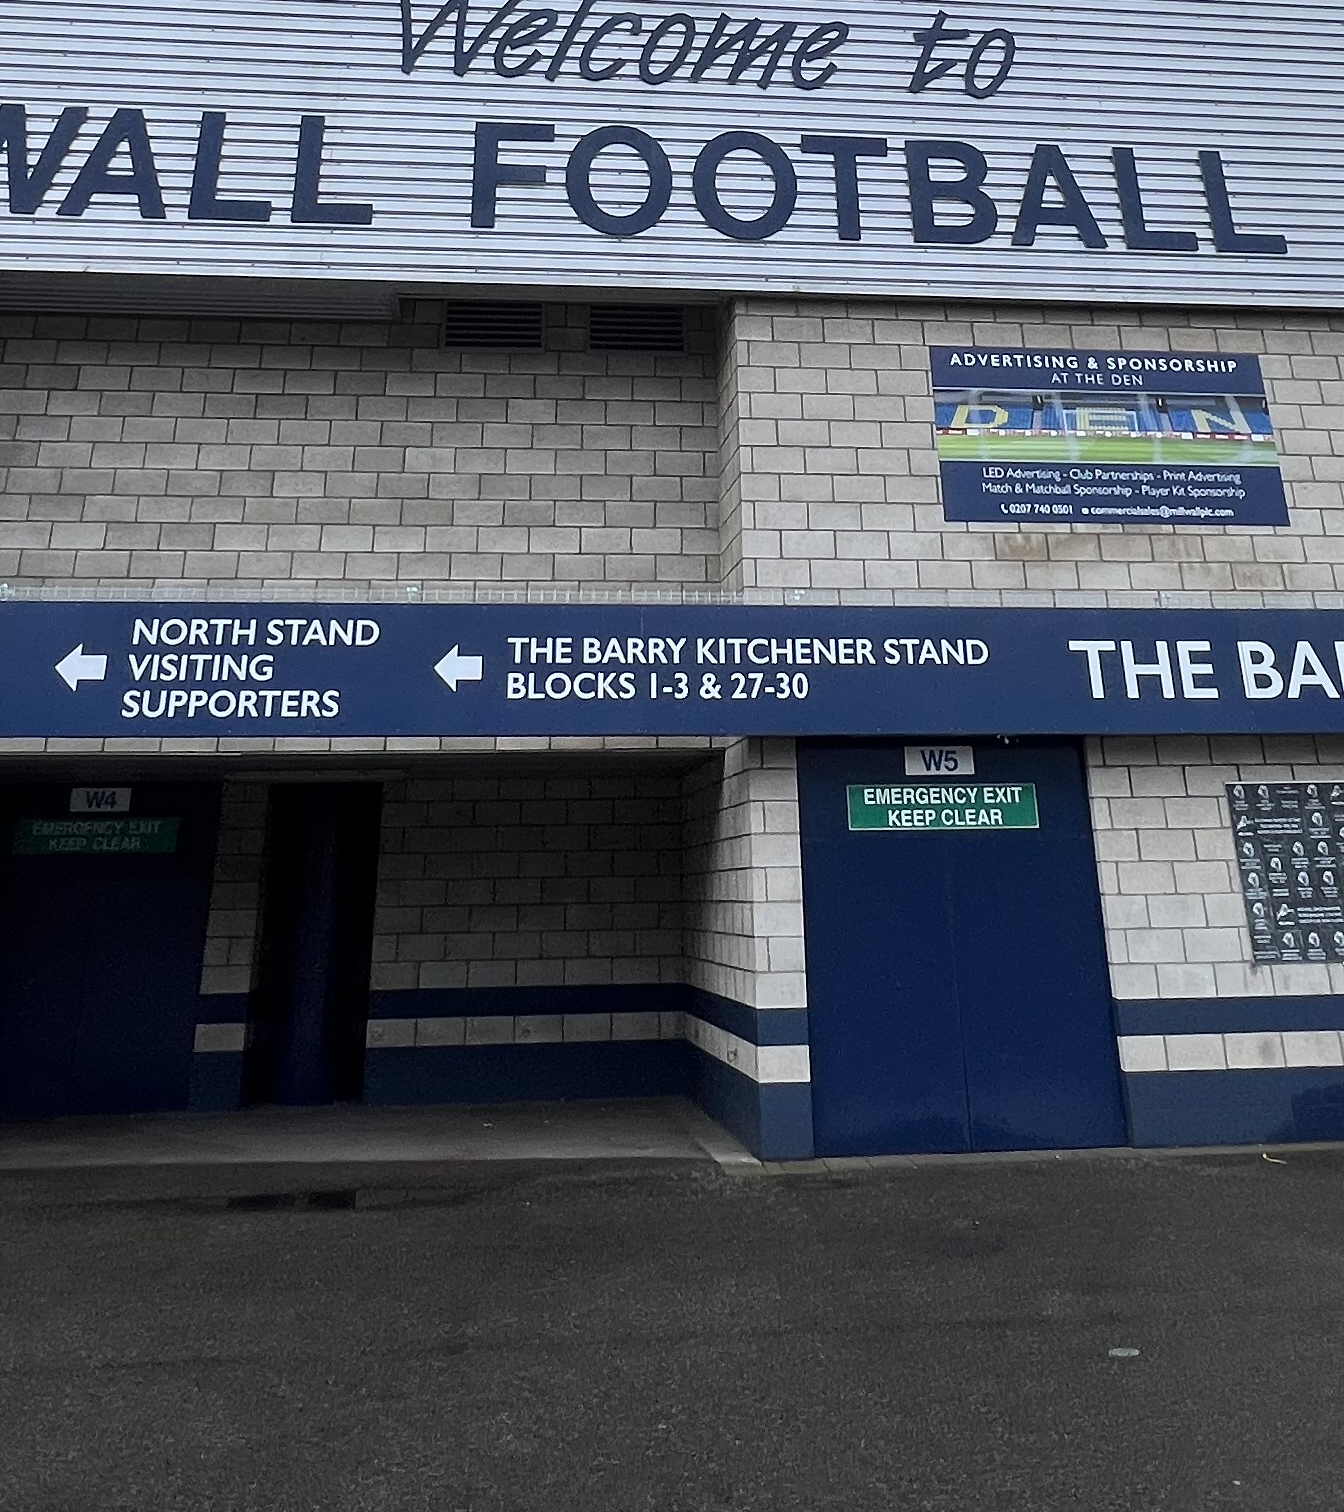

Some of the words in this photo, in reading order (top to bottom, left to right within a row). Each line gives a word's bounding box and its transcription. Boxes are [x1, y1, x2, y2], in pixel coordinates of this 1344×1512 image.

[910, 9, 1018, 100] to
[470, 121, 1288, 254] FOOTBALL
[949, 352, 1078, 370] ADVERTISING
[1087, 356, 1099, 370] &
[1107, 356, 1237, 374] SPONSORSHIP
[1050, 372, 1069, 384] AT
[1074, 373, 1105, 386] THE
[1111, 374, 1144, 387] DEN
[982, 467, 1004, 478] LED
[1006, 468, 1061, 482] Advertising
[1069, 468, 1093, 480] Club
[1095, 469, 1154, 482] Partnerships
[1163, 470, 1187, 482] Print
[1187, 470, 1242, 485] Advertising
[982, 482, 1012, 494] Match
[1015, 483, 1023, 494] &
[1025, 483, 1071, 495] Matchball
[1073, 484, 1132, 498] Sponsorship
[1141, 485, 1170, 498] Player
[1187, 486, 1246, 499] Sponsorship
[1009, 503, 1032, 514] 0207
[1033, 504, 1050, 514] 740
[132, 618, 257, 646] NORTH
[266, 619, 380, 646] STAND
[507, 637, 573, 664] THE
[582, 637, 687, 664] BARRY
[696, 637, 876, 665] KITCHENER
[883, 638, 990, 666] STAND
[128, 654, 274, 681] VISITING
[1068, 640, 1218, 700] THE
[506, 672, 636, 700] BLOCKS
[649, 672, 689, 700] 1-3
[699, 672, 722, 699] &
[730, 672, 809, 699] 27-30
[121, 690, 340, 718] SUPPORTERS
[921, 750, 958, 771] W5
[86, 791, 117, 809] W4
[864, 787, 978, 805] EMERGENCY
[984, 787, 1022, 804] EXIT
[32, 821, 124, 835] EMERGENCY
[129, 820, 162, 834] EXIT
[888, 809, 936, 827] KEEP
[941, 809, 1003, 826] CLEAR
